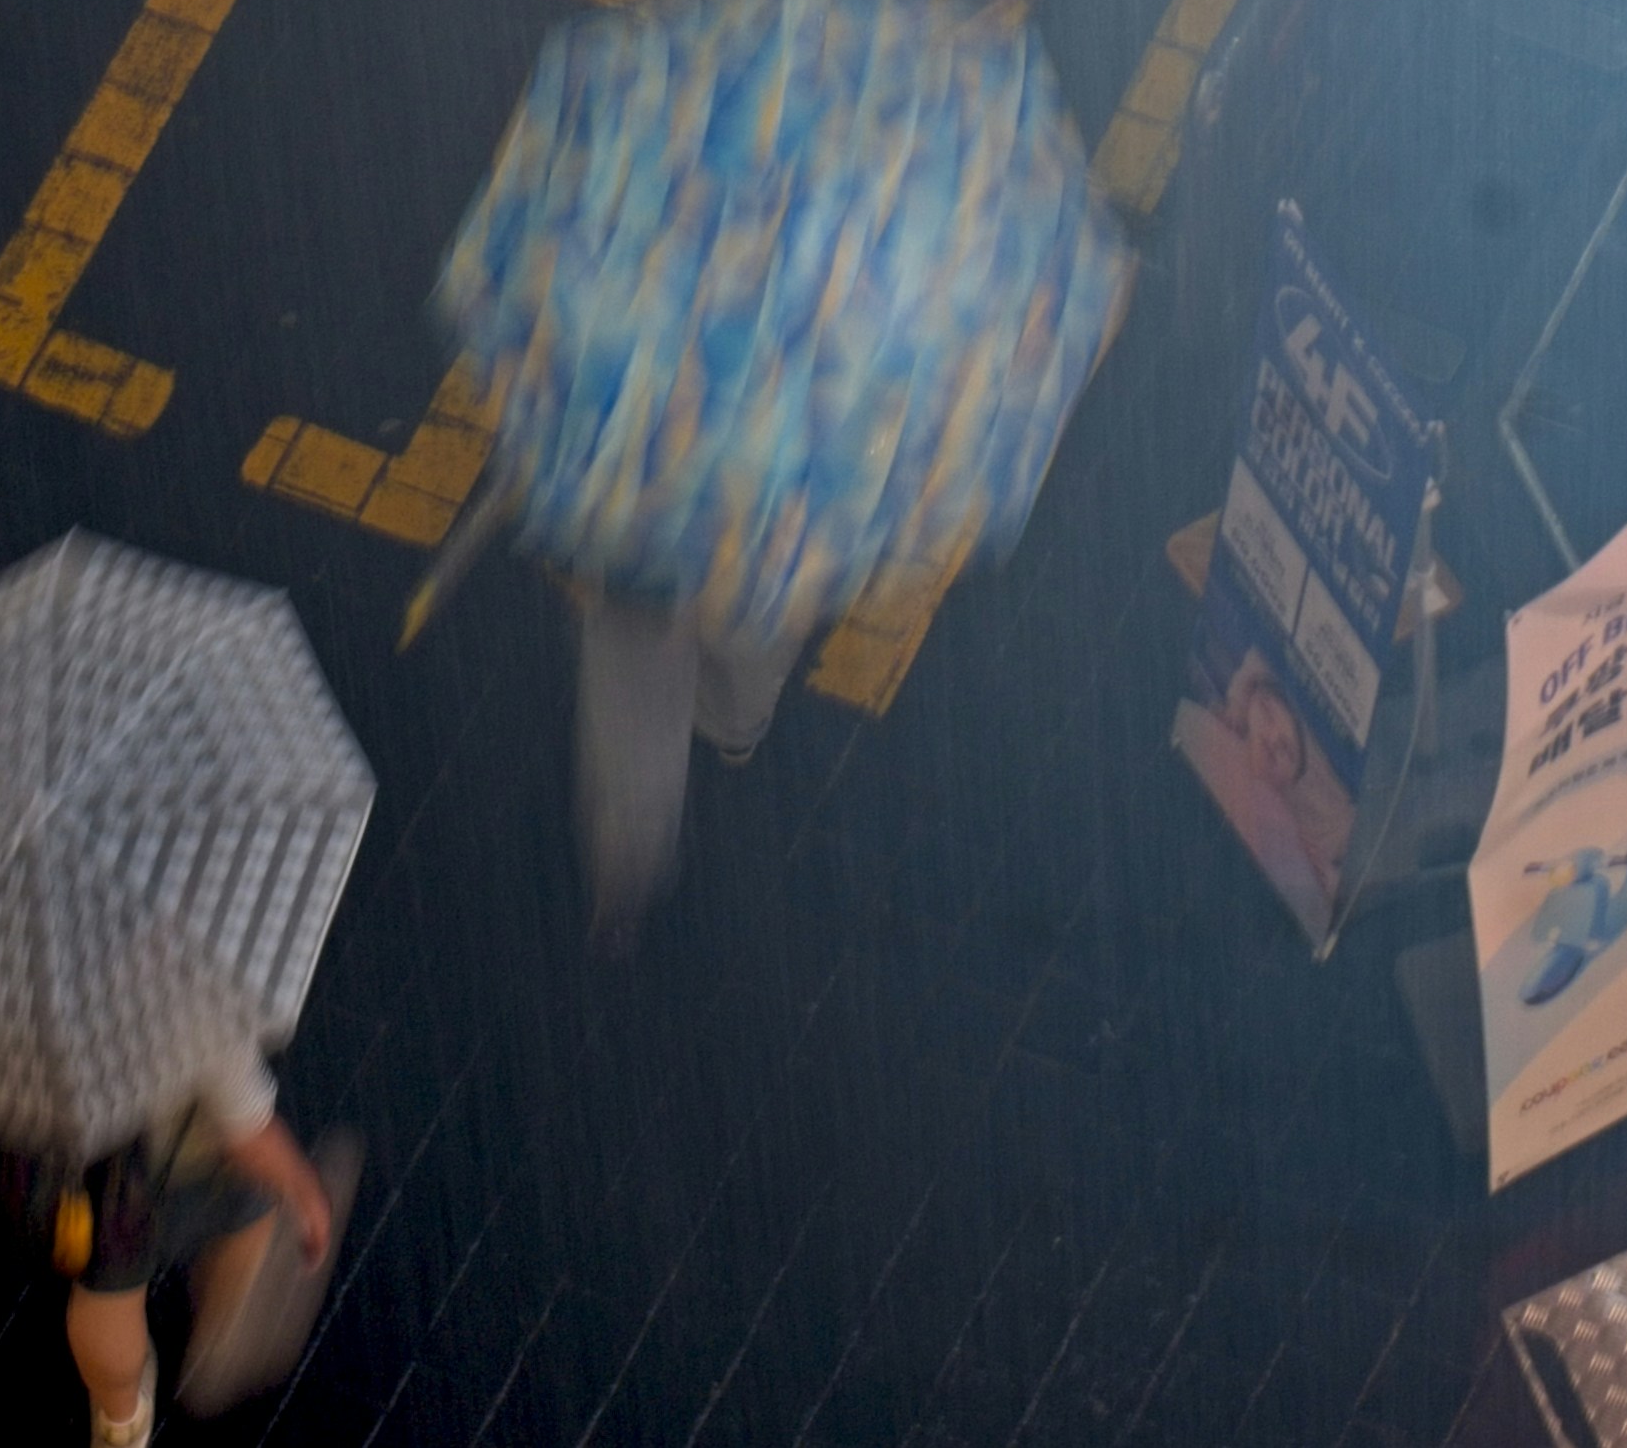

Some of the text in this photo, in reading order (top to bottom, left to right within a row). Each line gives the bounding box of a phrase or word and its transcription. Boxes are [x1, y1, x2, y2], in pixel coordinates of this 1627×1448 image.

[1249, 395, 1345, 547] COLOR
[1257, 356, 1398, 580] PERSONAL
[1539, 634, 1595, 706] OFF
